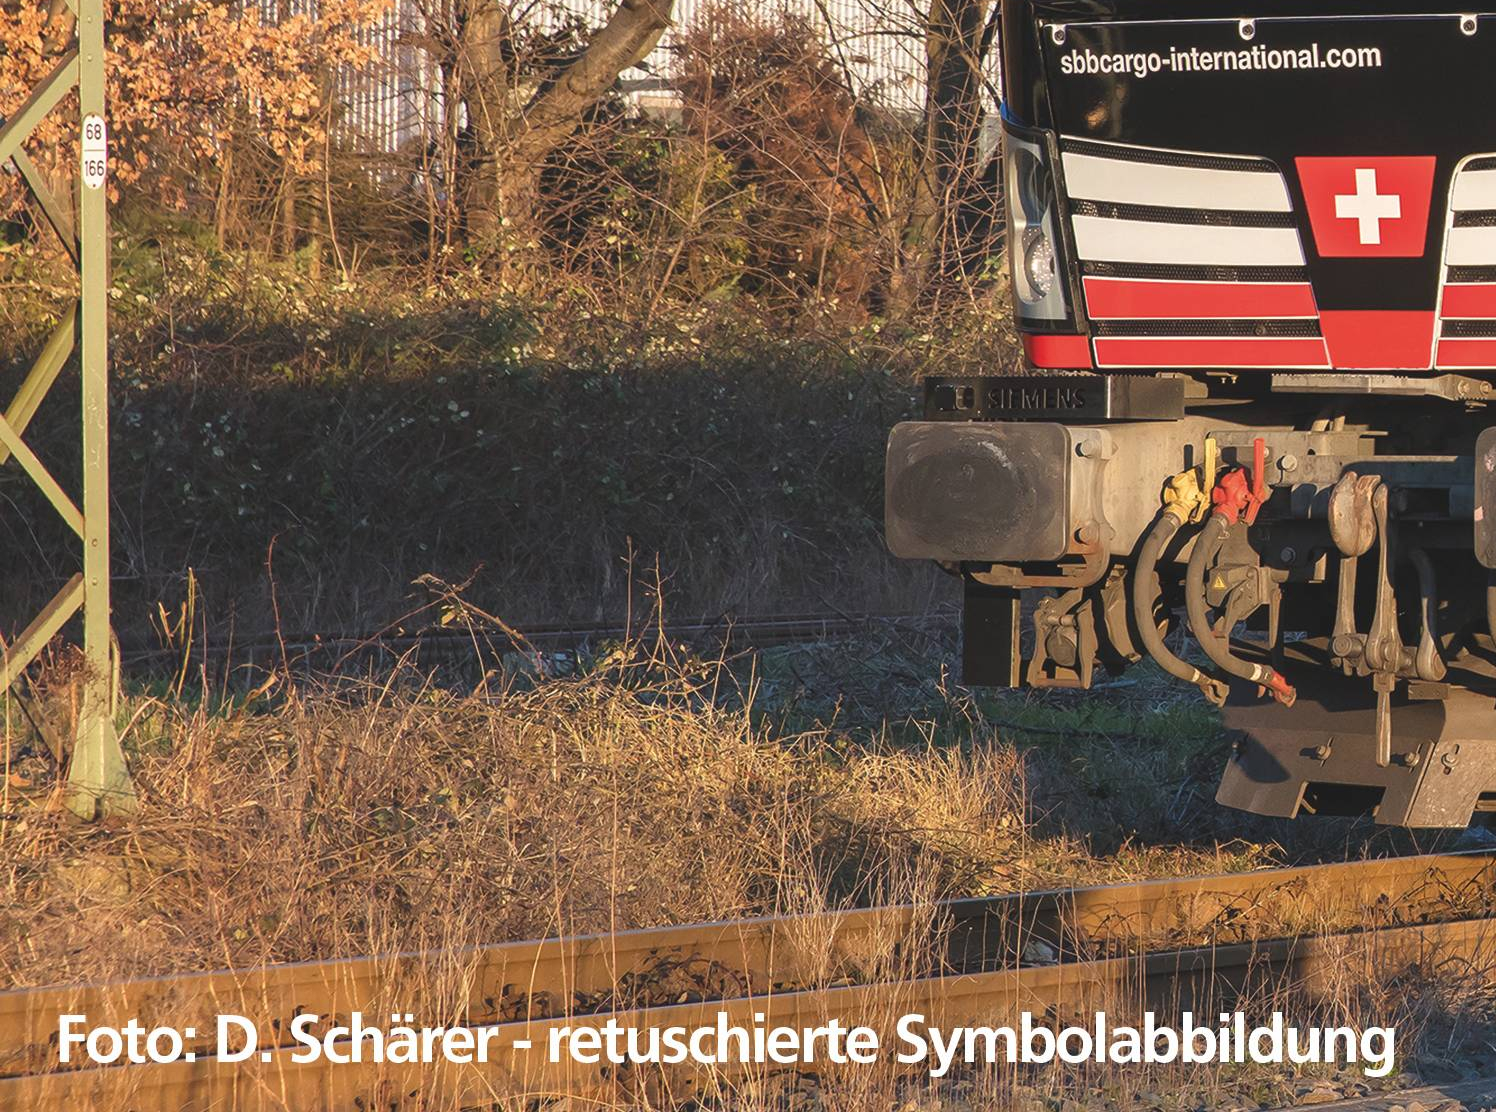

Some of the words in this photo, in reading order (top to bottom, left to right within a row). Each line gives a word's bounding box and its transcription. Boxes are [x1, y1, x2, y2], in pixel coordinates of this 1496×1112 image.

[1060, 41, 1382, 75] sbbcargo-international.com
[86, 123, 102, 140] 68
[85, 160, 104, 176] 166
[988, 389, 1084, 408] SIEMENS
